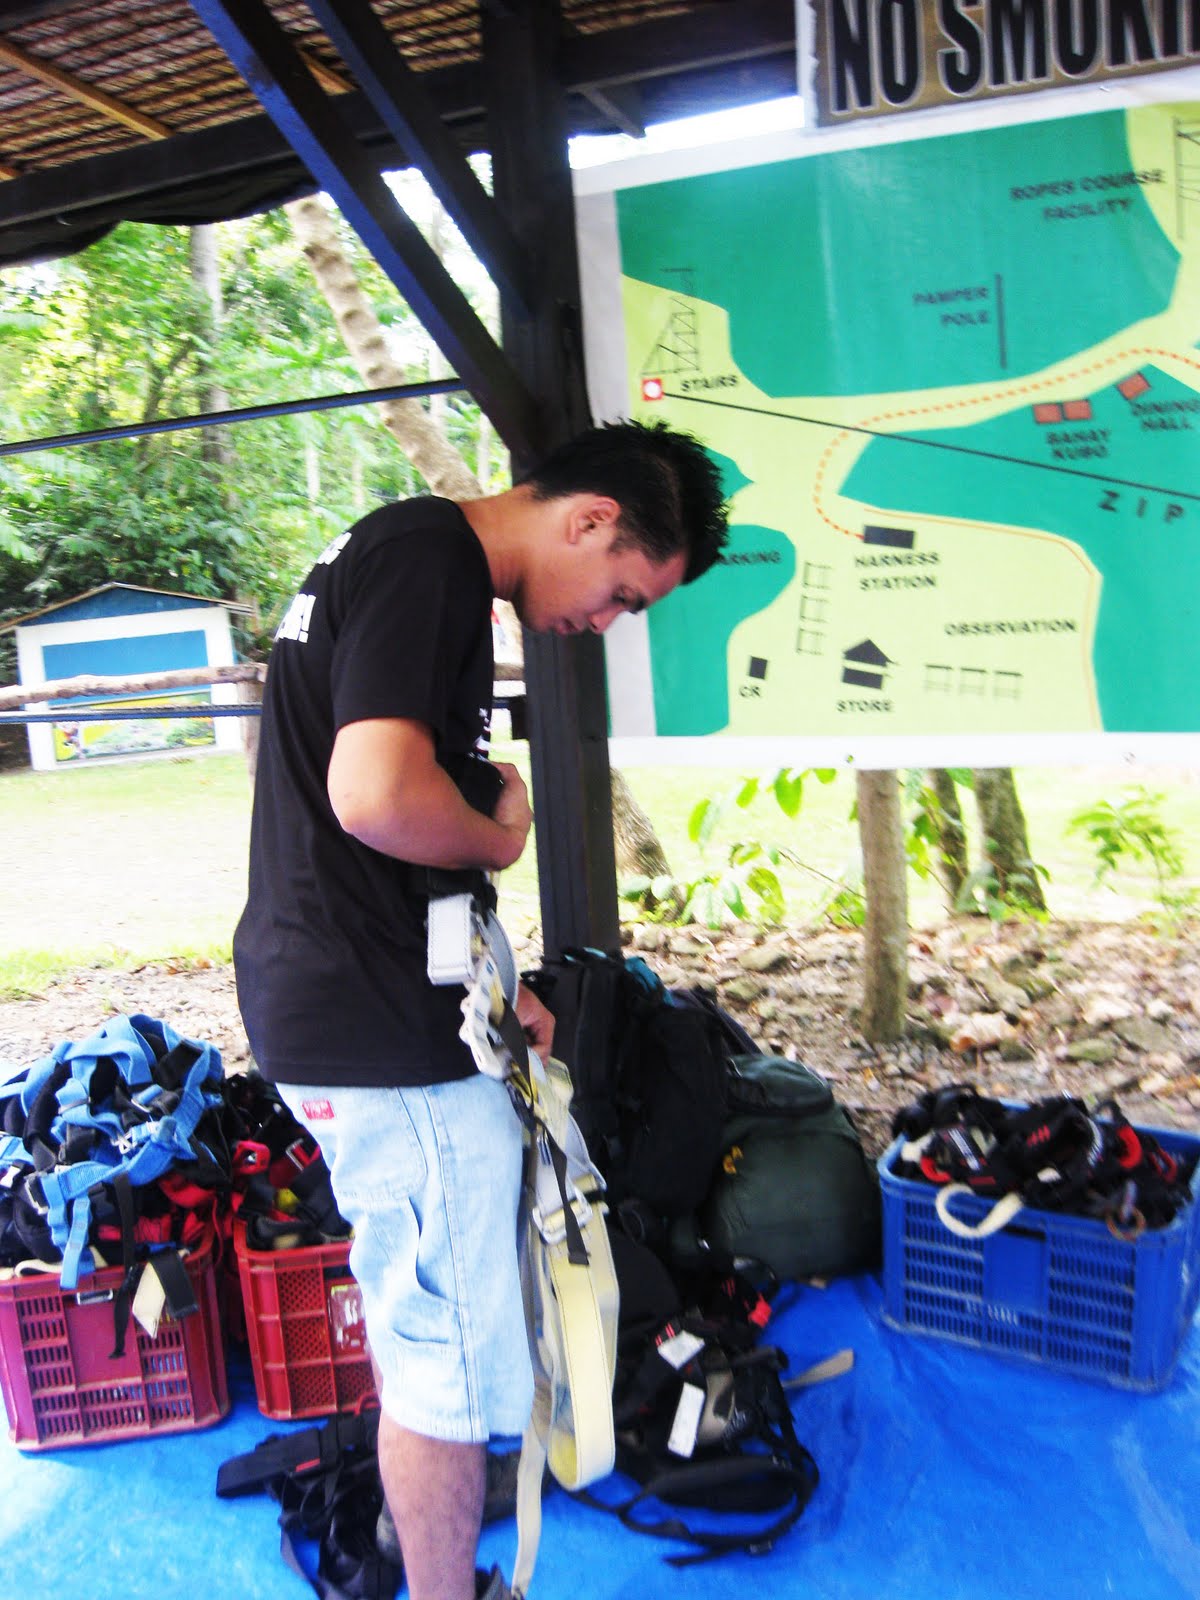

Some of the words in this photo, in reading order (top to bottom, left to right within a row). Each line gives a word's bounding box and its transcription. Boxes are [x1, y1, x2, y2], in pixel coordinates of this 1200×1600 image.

[830, 0, 921, 113] NO
[1080, 169, 1165, 192] COURSE
[1043, 199, 1131, 220] FACILITY
[941, 310, 989, 327] POLE
[681, 375, 738, 392] STAIRS
[1046, 429, 1110, 445] BAHAY
[1052, 444, 1108, 460] KUBO
[717, 550, 781, 566] ARKING
[855, 552, 940, 567] HARNESS
[860, 575, 936, 591] STATION
[944, 619, 1078, 636] OBSERVATION
[837, 699, 893, 714] STORE
